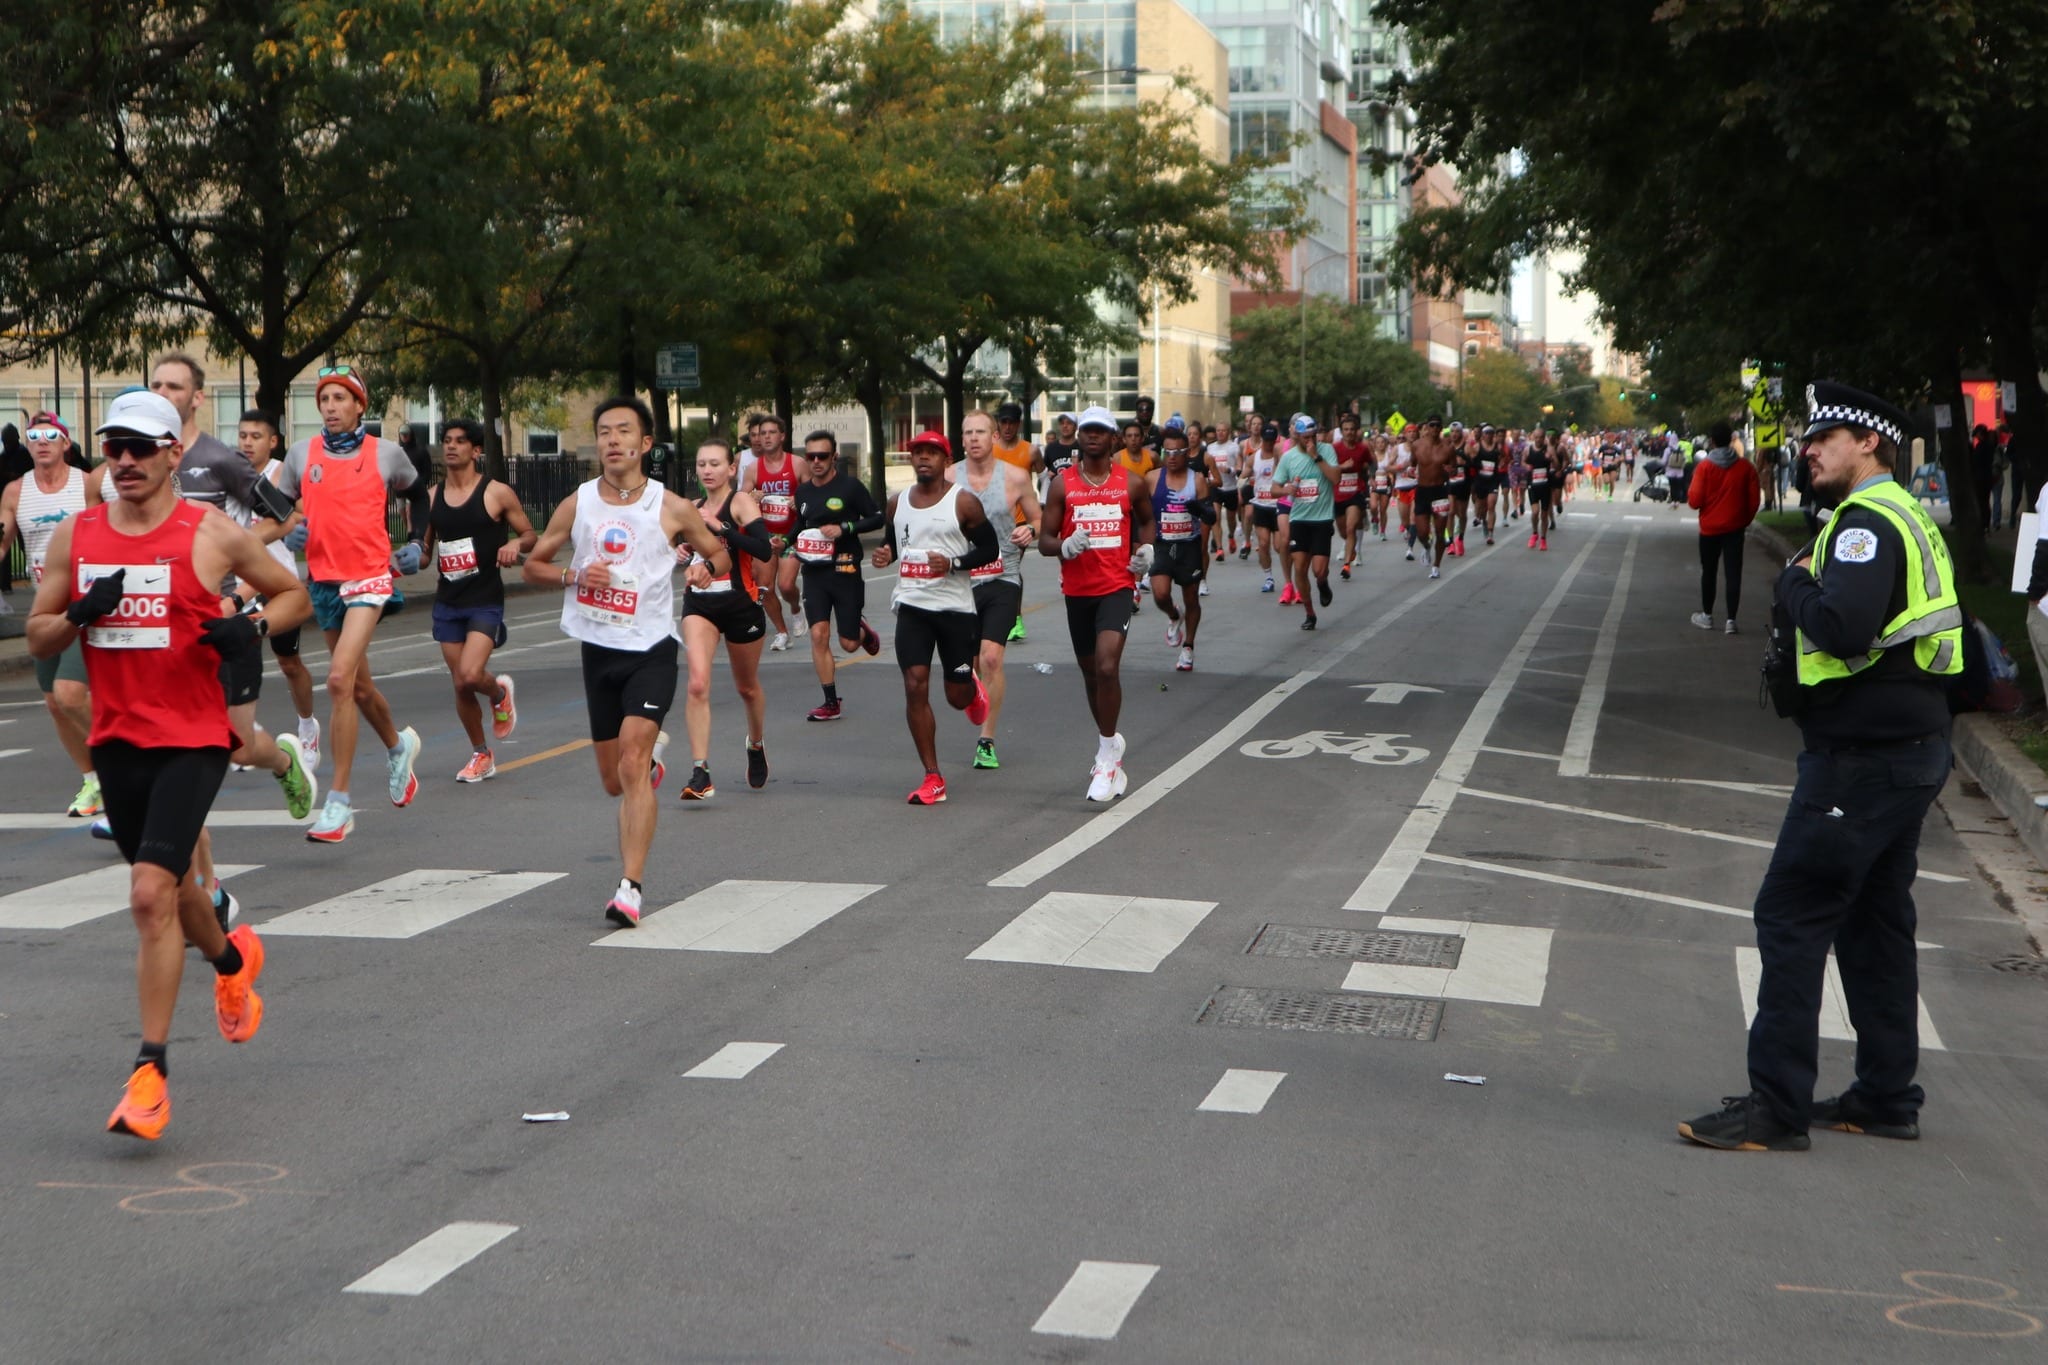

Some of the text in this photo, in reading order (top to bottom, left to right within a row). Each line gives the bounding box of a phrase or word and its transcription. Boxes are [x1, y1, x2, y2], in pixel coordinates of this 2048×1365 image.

[1088, 521, 1120, 532] 13292
[1840, 530, 1872, 545] CHICAGO
[797, 540, 832, 551] B 2359
[1840, 549, 1869, 559] POLICE
[444, 553, 474, 568] 1214
[901, 563, 909, 574] B
[579, 585, 588, 598] B
[593, 587, 635, 608] 6365
